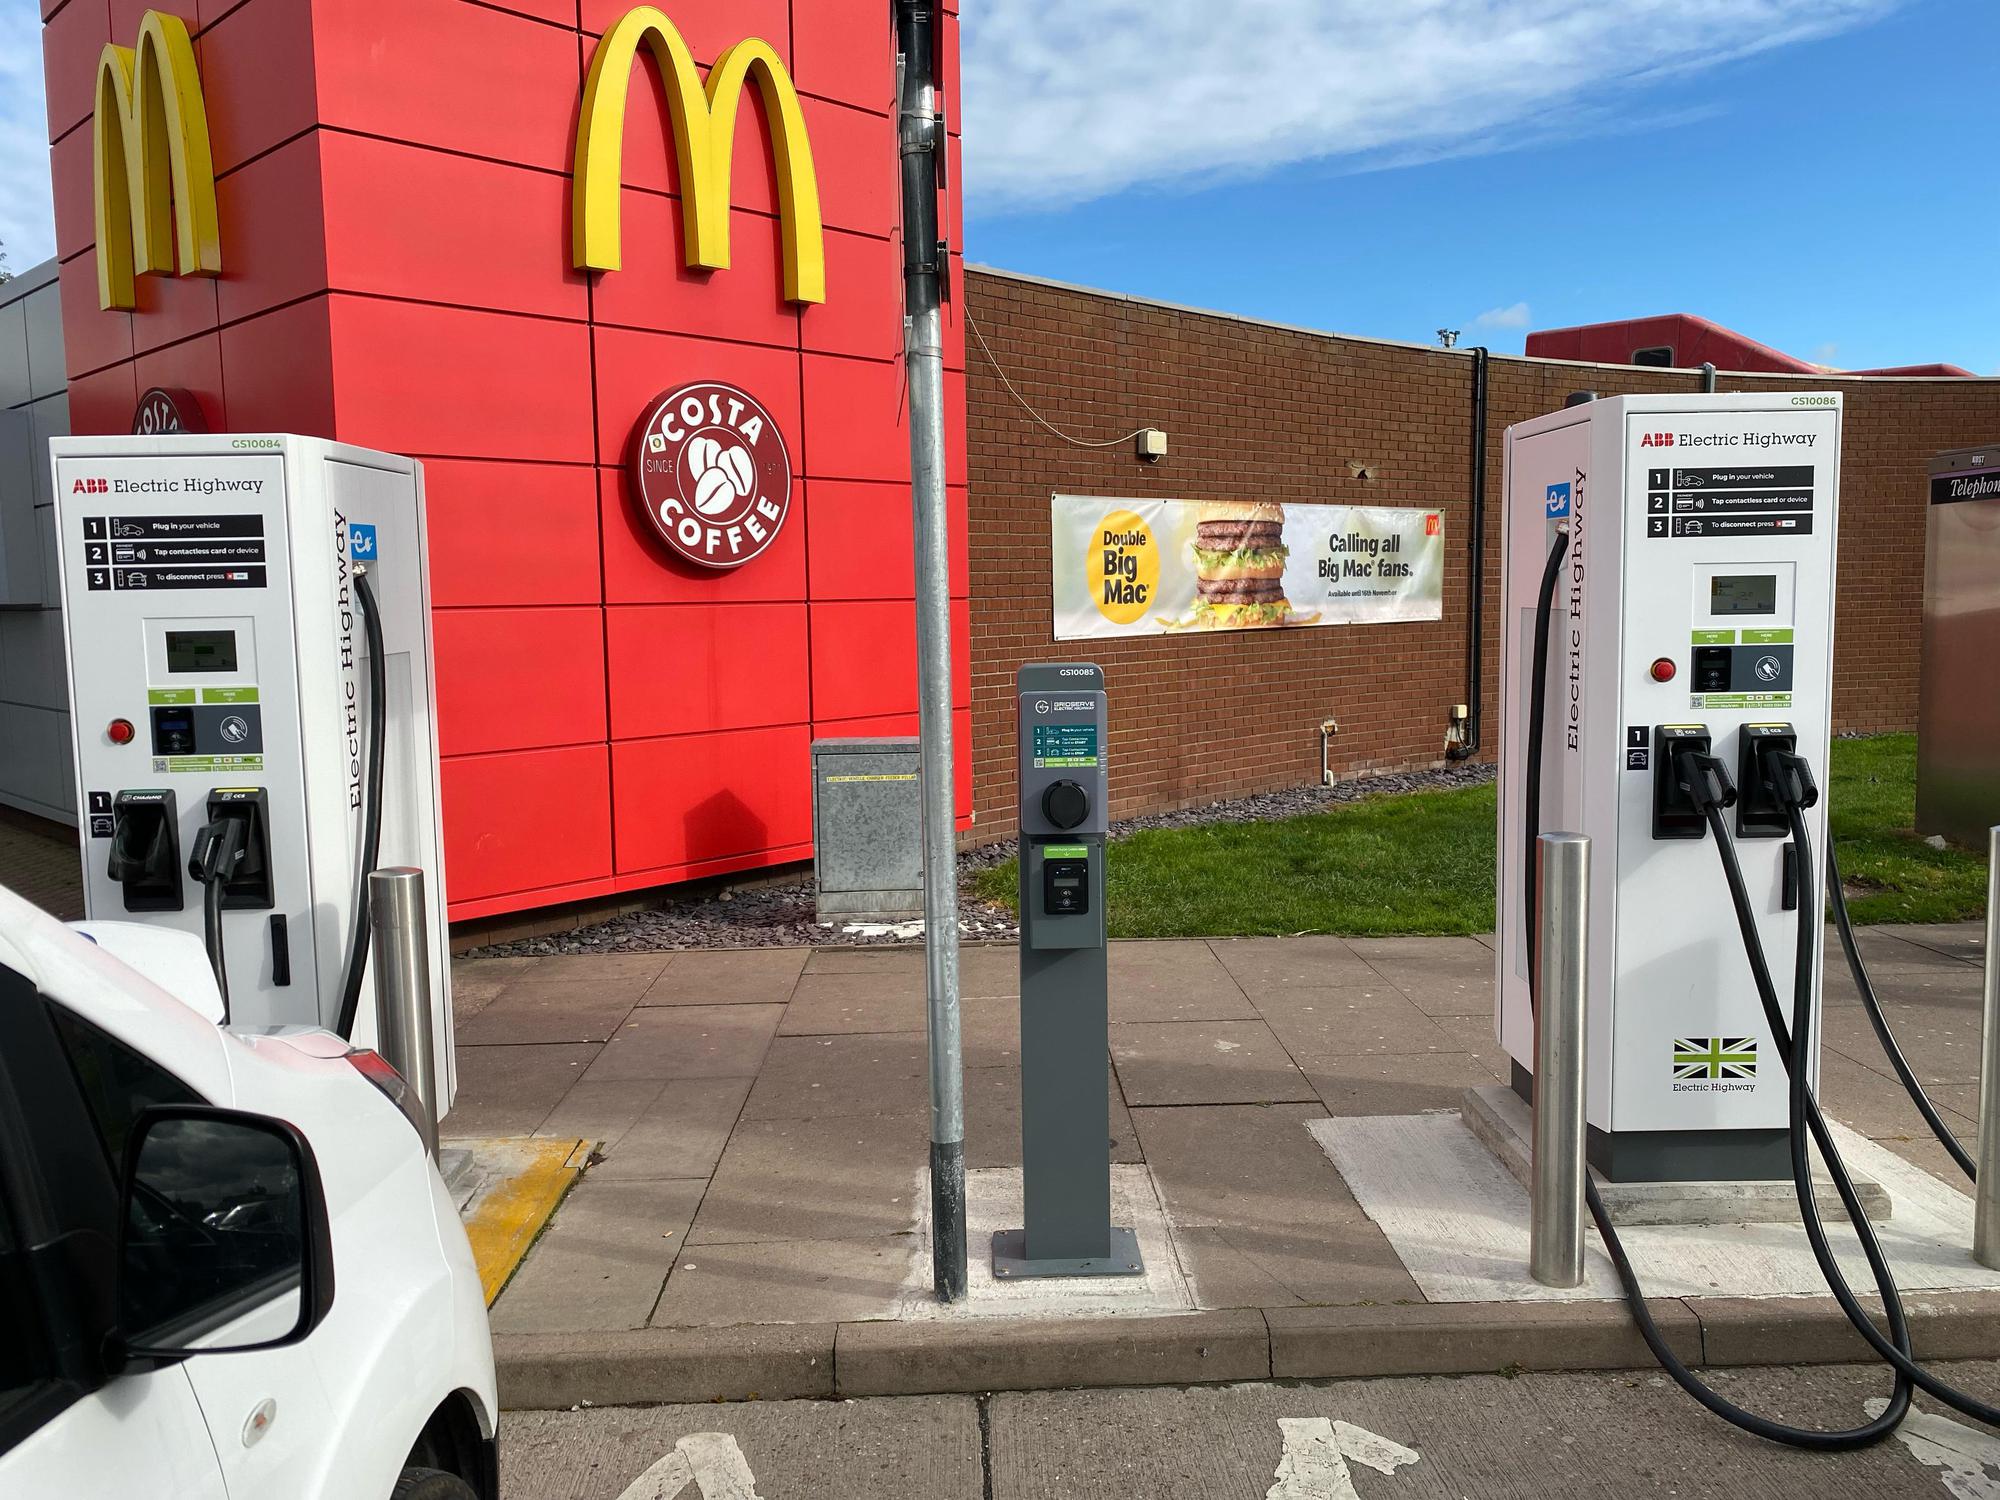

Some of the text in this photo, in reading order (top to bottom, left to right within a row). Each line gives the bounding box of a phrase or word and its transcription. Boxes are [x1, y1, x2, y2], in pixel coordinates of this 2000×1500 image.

[1791, 397, 1836, 406] GS10086
[137, 400, 178, 435] OSTA
[661, 394, 763, 447] COSTA
[232, 439, 281, 449] GS10084
[1641, 432, 1817, 448] ABB Electric Highway
[646, 459, 673, 473] SINCE
[1655, 473, 1661, 484] 1
[1712, 473, 1728, 482] Plug
[73, 477, 263, 495] ABB Electric Highway
[1950, 476, 2000, 498] Telephon
[1654, 497, 1663, 509] 2
[1725, 497, 1763, 505] contactless
[90, 522, 97, 534] 1
[152, 522, 170, 531] Plug
[171, 522, 178, 530] in
[178, 523, 194, 531] your
[660, 495, 780, 555] COFFEE
[1654, 521, 1663, 532] 3
[1720, 520, 1757, 528] disconnect
[1103, 530, 1146, 546] Double
[1329, 532, 1400, 557] Calling all
[91, 547, 102, 560] 2
[154, 548, 168, 556] Tap
[168, 547, 209, 555] contactless
[210, 547, 227, 555] card
[236, 546, 259, 554] device
[1103, 546, 1137, 583] Big
[1318, 557, 1340, 583] Big
[1377, 558, 1413, 577] fans.
[94, 572, 104, 584] 3
[156, 572, 225, 581] To disconnect press
[1351, 589, 1361, 597] until
[1568, 467, 1587, 752] Electric Highway
[334, 508, 362, 810] Electric Highway
[1634, 730, 1641, 742] 1
[96, 796, 103, 808] 1
[1672, 1083, 1755, 1093] Electric Highway
